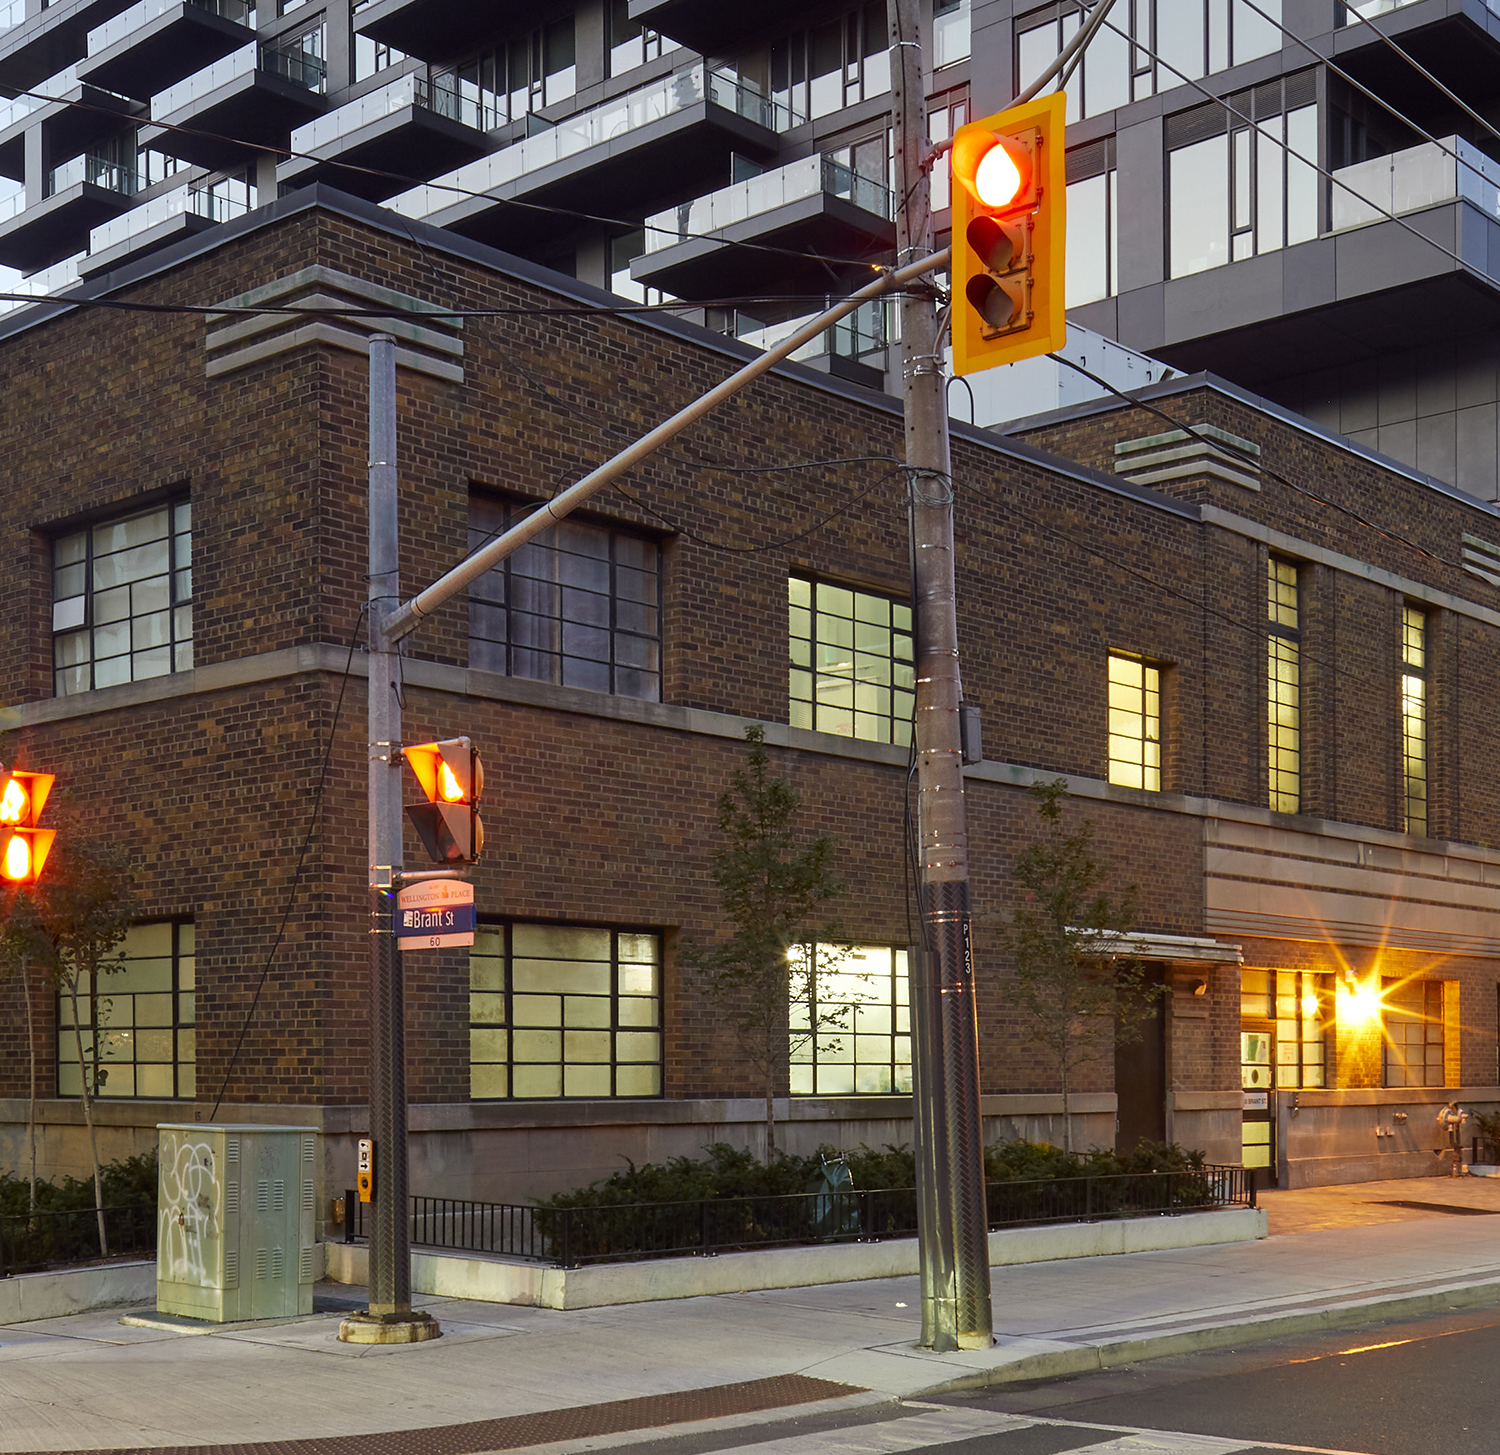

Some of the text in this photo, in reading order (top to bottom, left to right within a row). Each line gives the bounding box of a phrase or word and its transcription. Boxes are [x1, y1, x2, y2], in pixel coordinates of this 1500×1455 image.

[401, 890, 470, 903] WELLINGTON PLACE
[414, 909, 454, 928] Brant St
[430, 937, 440, 946] 60
